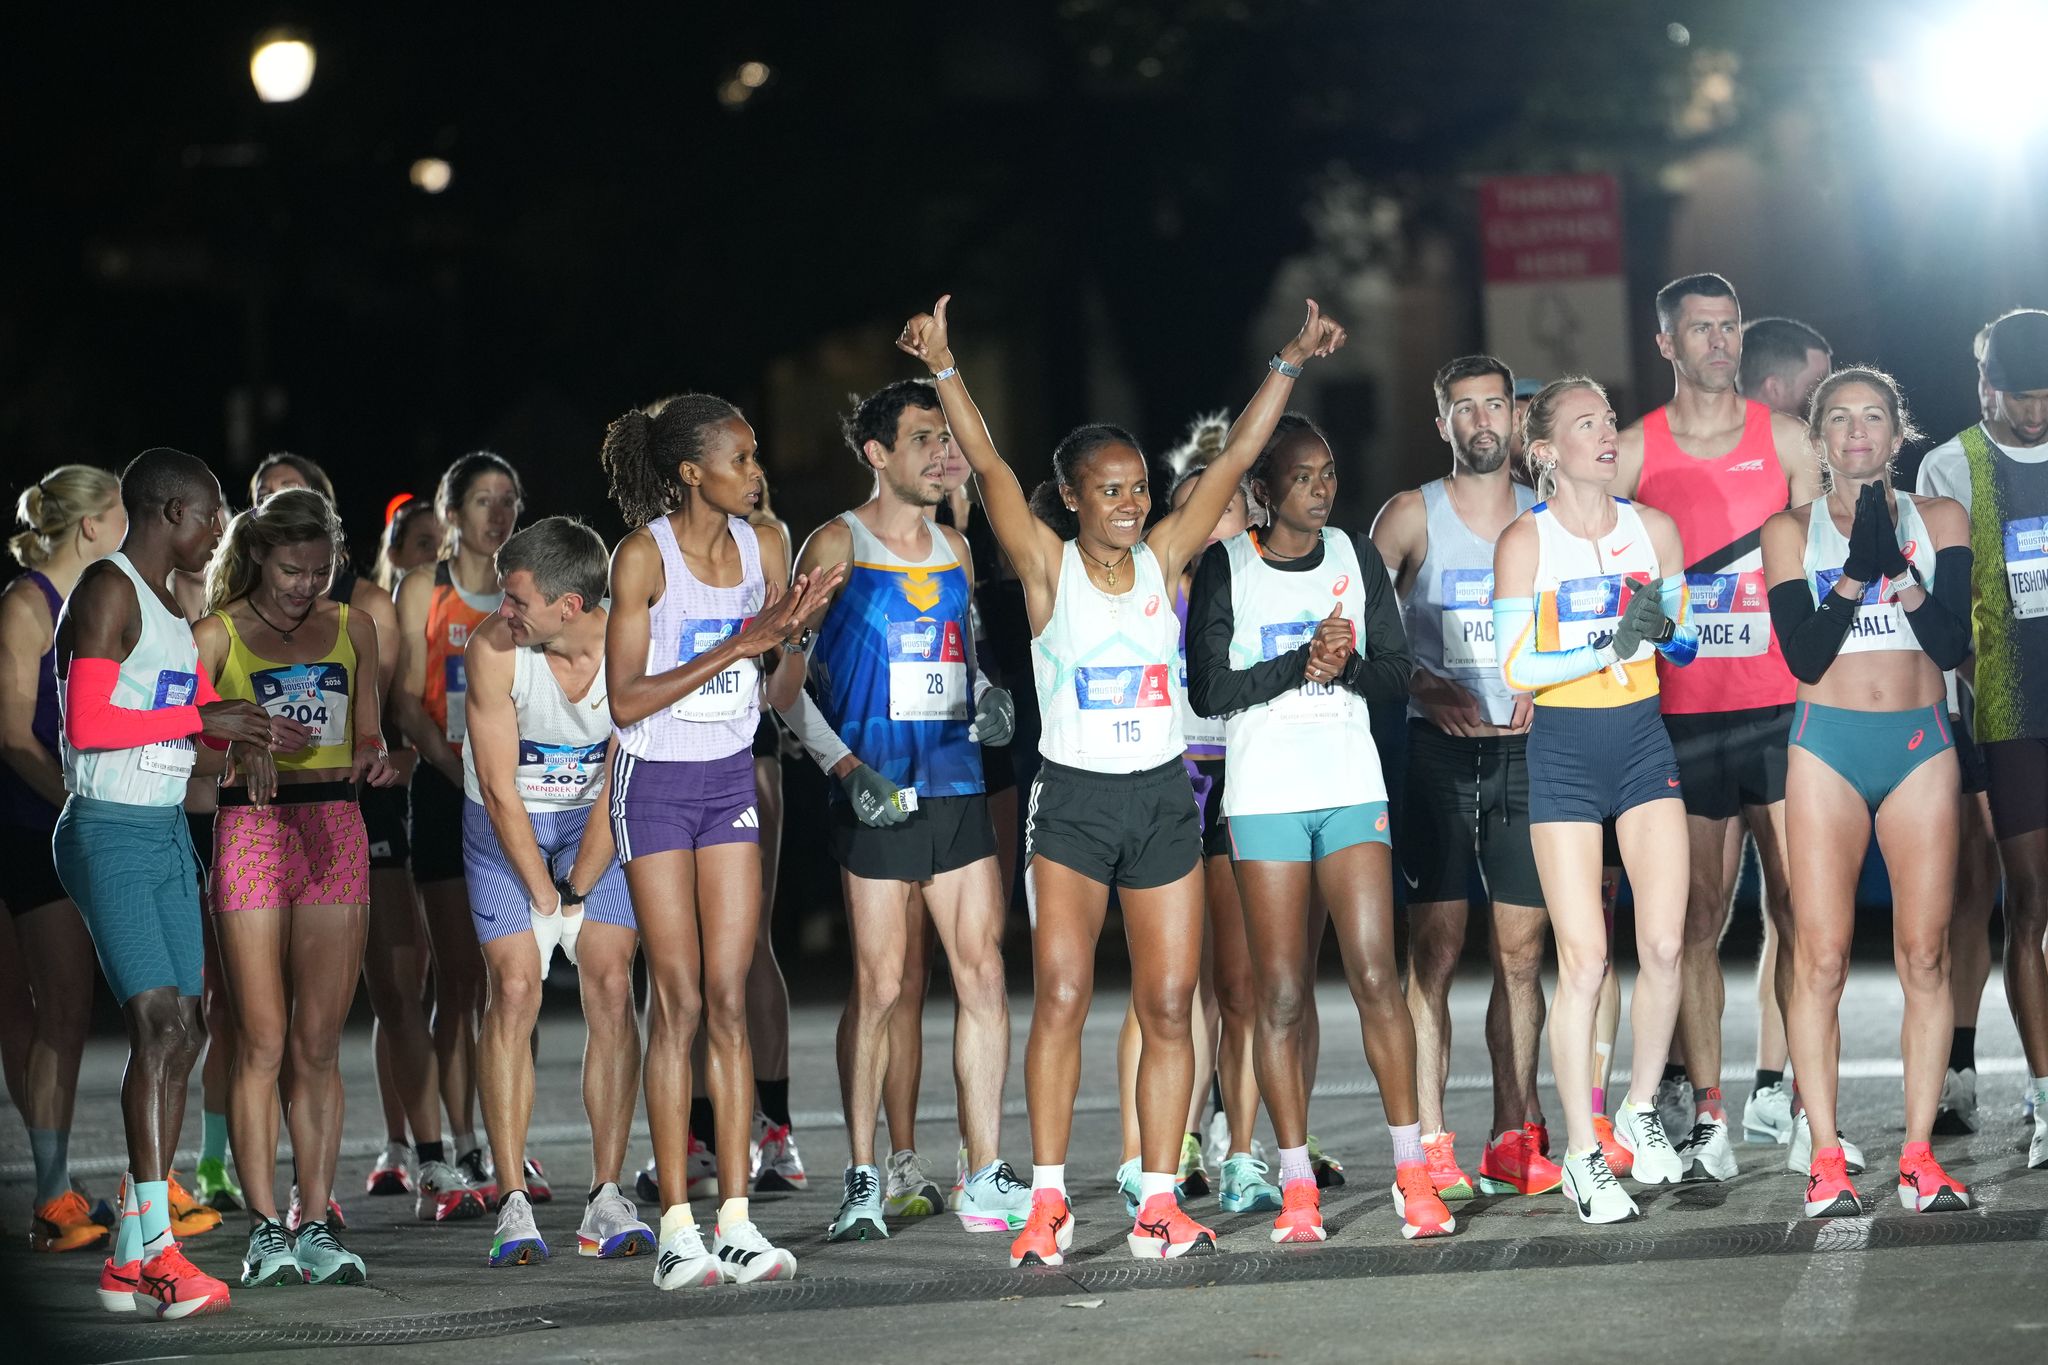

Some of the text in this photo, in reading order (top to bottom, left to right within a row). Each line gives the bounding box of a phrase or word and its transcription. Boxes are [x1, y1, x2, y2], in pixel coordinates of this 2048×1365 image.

[1690, 591, 1718, 600] OUSTON
[1851, 615, 1896, 638] HALL
[1696, 624, 1751, 645] PACE 4
[902, 640, 930, 648] HOUSTON
[1277, 641, 1309, 650] HOUST
[281, 681, 316, 692] HOUSTON
[324, 679, 341, 687] 2026
[699, 671, 741, 696] JANET
[926, 673, 944, 694] 28
[1089, 686, 1123, 695] HOUSTON
[281, 705, 328, 725] 204
[1112, 720, 1141, 743] 115
[541, 775, 588, 784] 205
